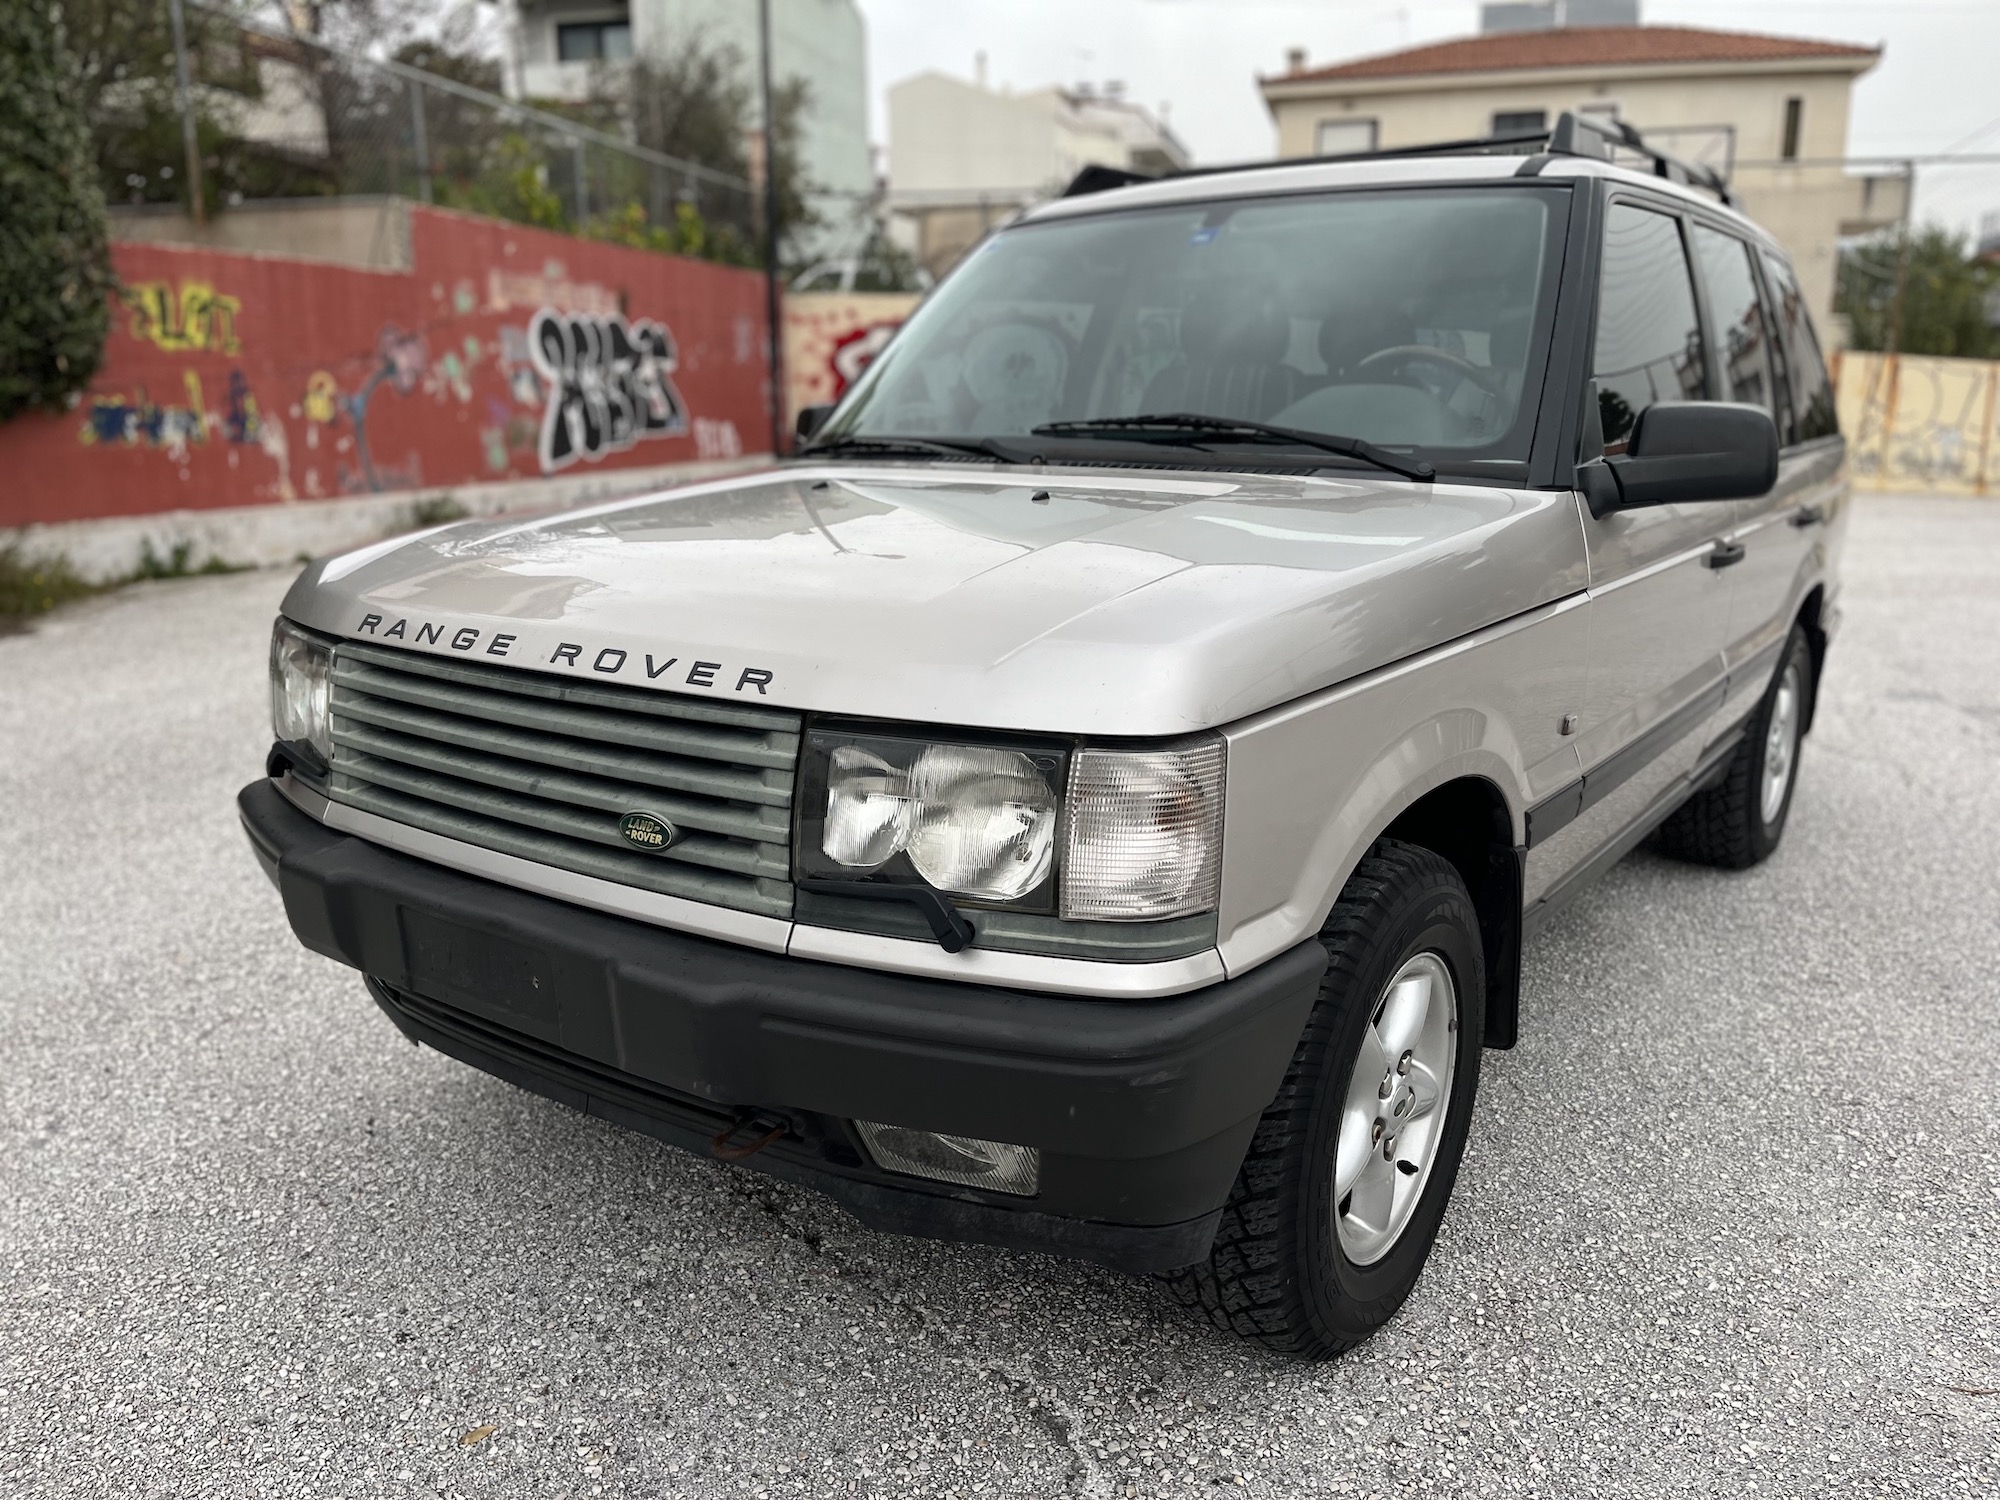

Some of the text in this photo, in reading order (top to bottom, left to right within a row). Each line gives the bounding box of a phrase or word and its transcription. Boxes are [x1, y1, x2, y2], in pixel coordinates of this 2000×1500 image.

[357, 613, 774, 695] RANGE ROVER
[628, 817, 654, 832] LAND
[630, 829, 662, 845] ROVER
